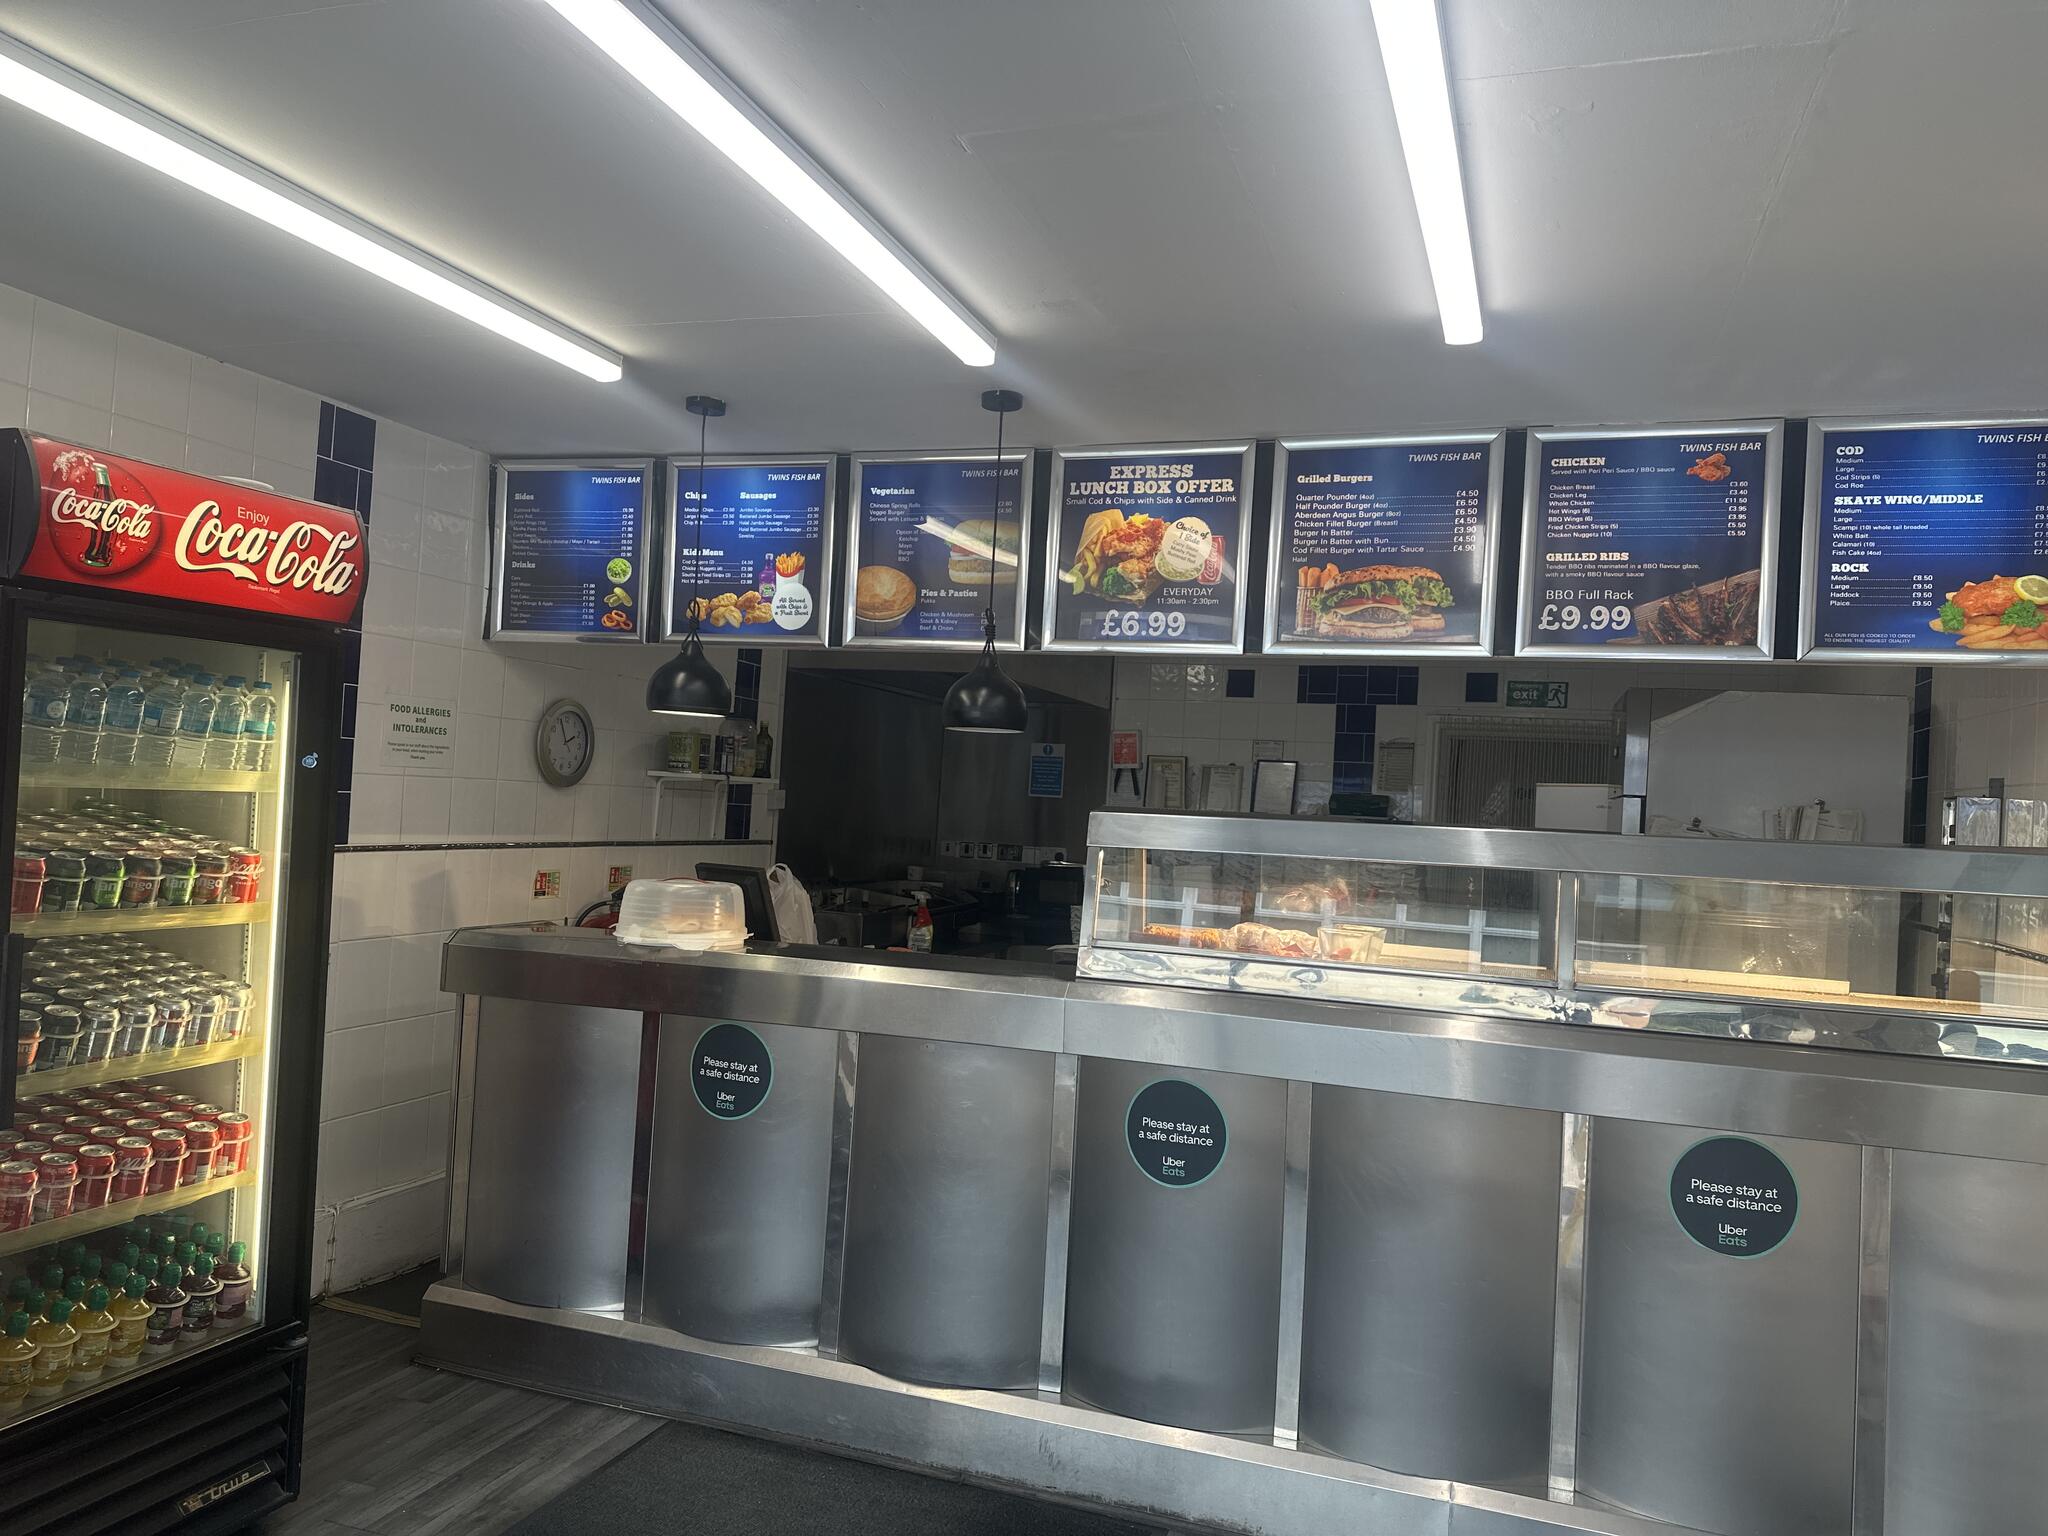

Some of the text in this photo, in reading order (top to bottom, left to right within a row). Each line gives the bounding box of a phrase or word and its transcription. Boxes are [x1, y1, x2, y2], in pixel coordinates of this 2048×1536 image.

[1977, 434, 2041, 443] TWINS FISH
[1680, 443, 1761, 452] TWINS FISH BAR
[1836, 446, 1864, 455] COD
[1409, 454, 1437, 462] TWINS
[1440, 453, 1460, 461] FISH
[1551, 457, 1605, 467] CHICKEN
[1110, 464, 1193, 479] EXPRESS
[1297, 474, 1373, 484] Grilled Burgers
[871, 487, 915, 496] Vegetarian
[1070, 479, 1234, 495] LUNCH BOX OFFER
[740, 492, 776, 500] Sausages
[1114, 497, 1135, 506] Chips
[1834, 494, 1983, 505] SKATE WING/MIDDLE
[1346, 502, 1370, 510] Burger
[52, 487, 155, 538] Coca-Cola
[237, 506, 270, 526] Enjoy
[1359, 511, 1383, 519] Burger
[1347, 520, 1371, 528] Burger
[1455, 517, 1477, 525] £4.50
[1176, 522, 1209, 540] Choice of
[1454, 535, 1475, 543] £4.50
[175, 500, 359, 595] Coca-Cola
[1330, 547, 1355, 555] Burger
[1546, 552, 1629, 562] GRILLED RIBS
[1831, 563, 1869, 572] ROCK
[1546, 590, 1634, 600] BBQ Full Rack
[1101, 609, 1186, 636] £6.99
[1538, 604, 1631, 630] £9.99
[1513, 689, 1537, 699] exit
[390, 704, 451, 717] FOOD ALLERGIES
[393, 724, 447, 735] INTOLERANCES
[704, 1056, 757, 1072] Please stay at
[706, 1069, 722, 1078] safe
[724, 1071, 759, 1083] distance
[717, 1091, 735, 1101] Uber
[716, 1101, 734, 1110] Eats
[1142, 1117, 1210, 1134] Please stay at
[1147, 1131, 1167, 1141] safe
[1169, 1133, 1213, 1146] distance
[1163, 1156, 1185, 1167] Uber
[1163, 1166, 1185, 1176] Eats
[1691, 1179, 1777, 1199] Please stay at
[1686, 1194, 1781, 1212] a safe distance
[1719, 1224, 1747, 1236] Uber
[1719, 1235, 1747, 1247] Eats
